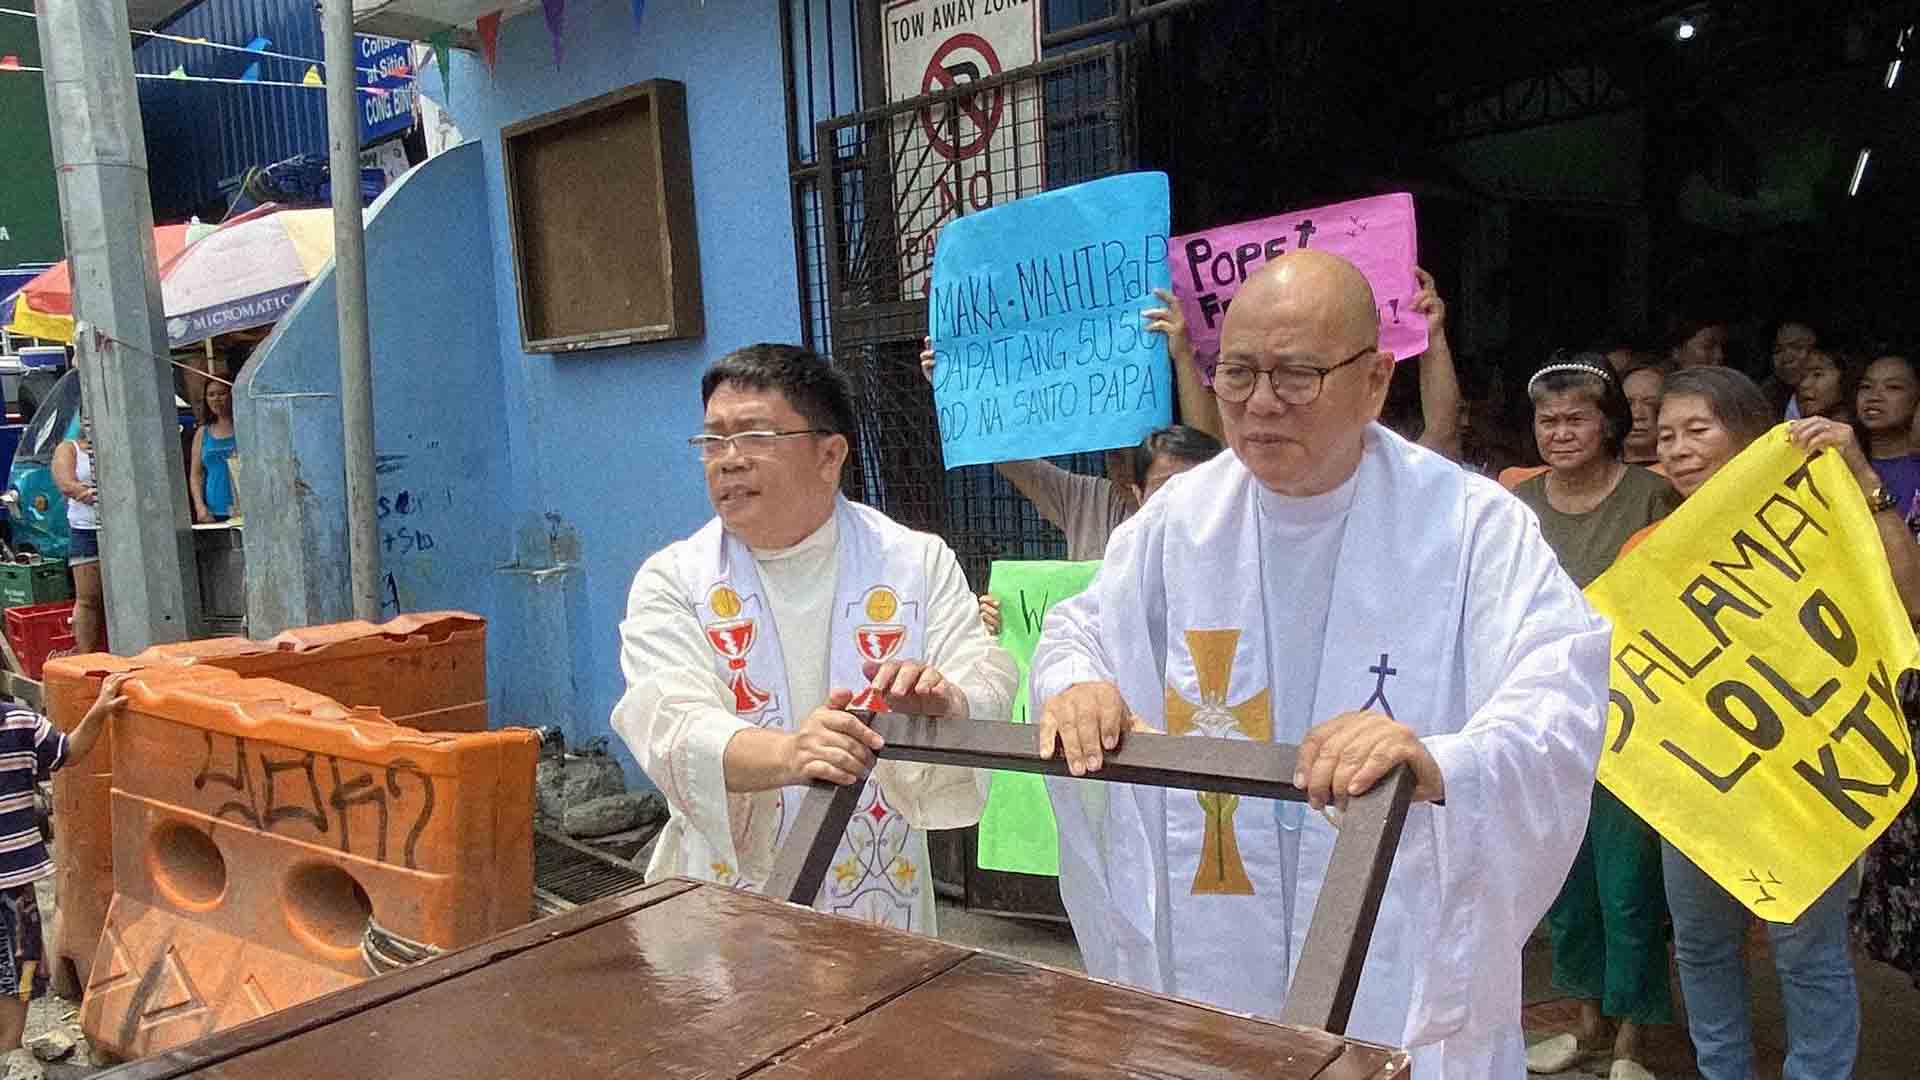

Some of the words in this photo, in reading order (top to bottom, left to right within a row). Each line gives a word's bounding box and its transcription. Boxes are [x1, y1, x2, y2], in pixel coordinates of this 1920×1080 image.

[892, 12, 924, 44] TOW
[932, 0, 975, 33] AWAY
[939, 169, 993, 217] NO
[1185, 236, 1288, 293] POPE
[192, 293, 291, 330] MICROMATIC
[1016, 327, 1067, 384] ANG
[978, 397, 1004, 436] NA
[1014, 381, 1078, 425] SANTO
[1088, 363, 1158, 416] PAPA
[1659, 588, 1858, 793] LOLO
